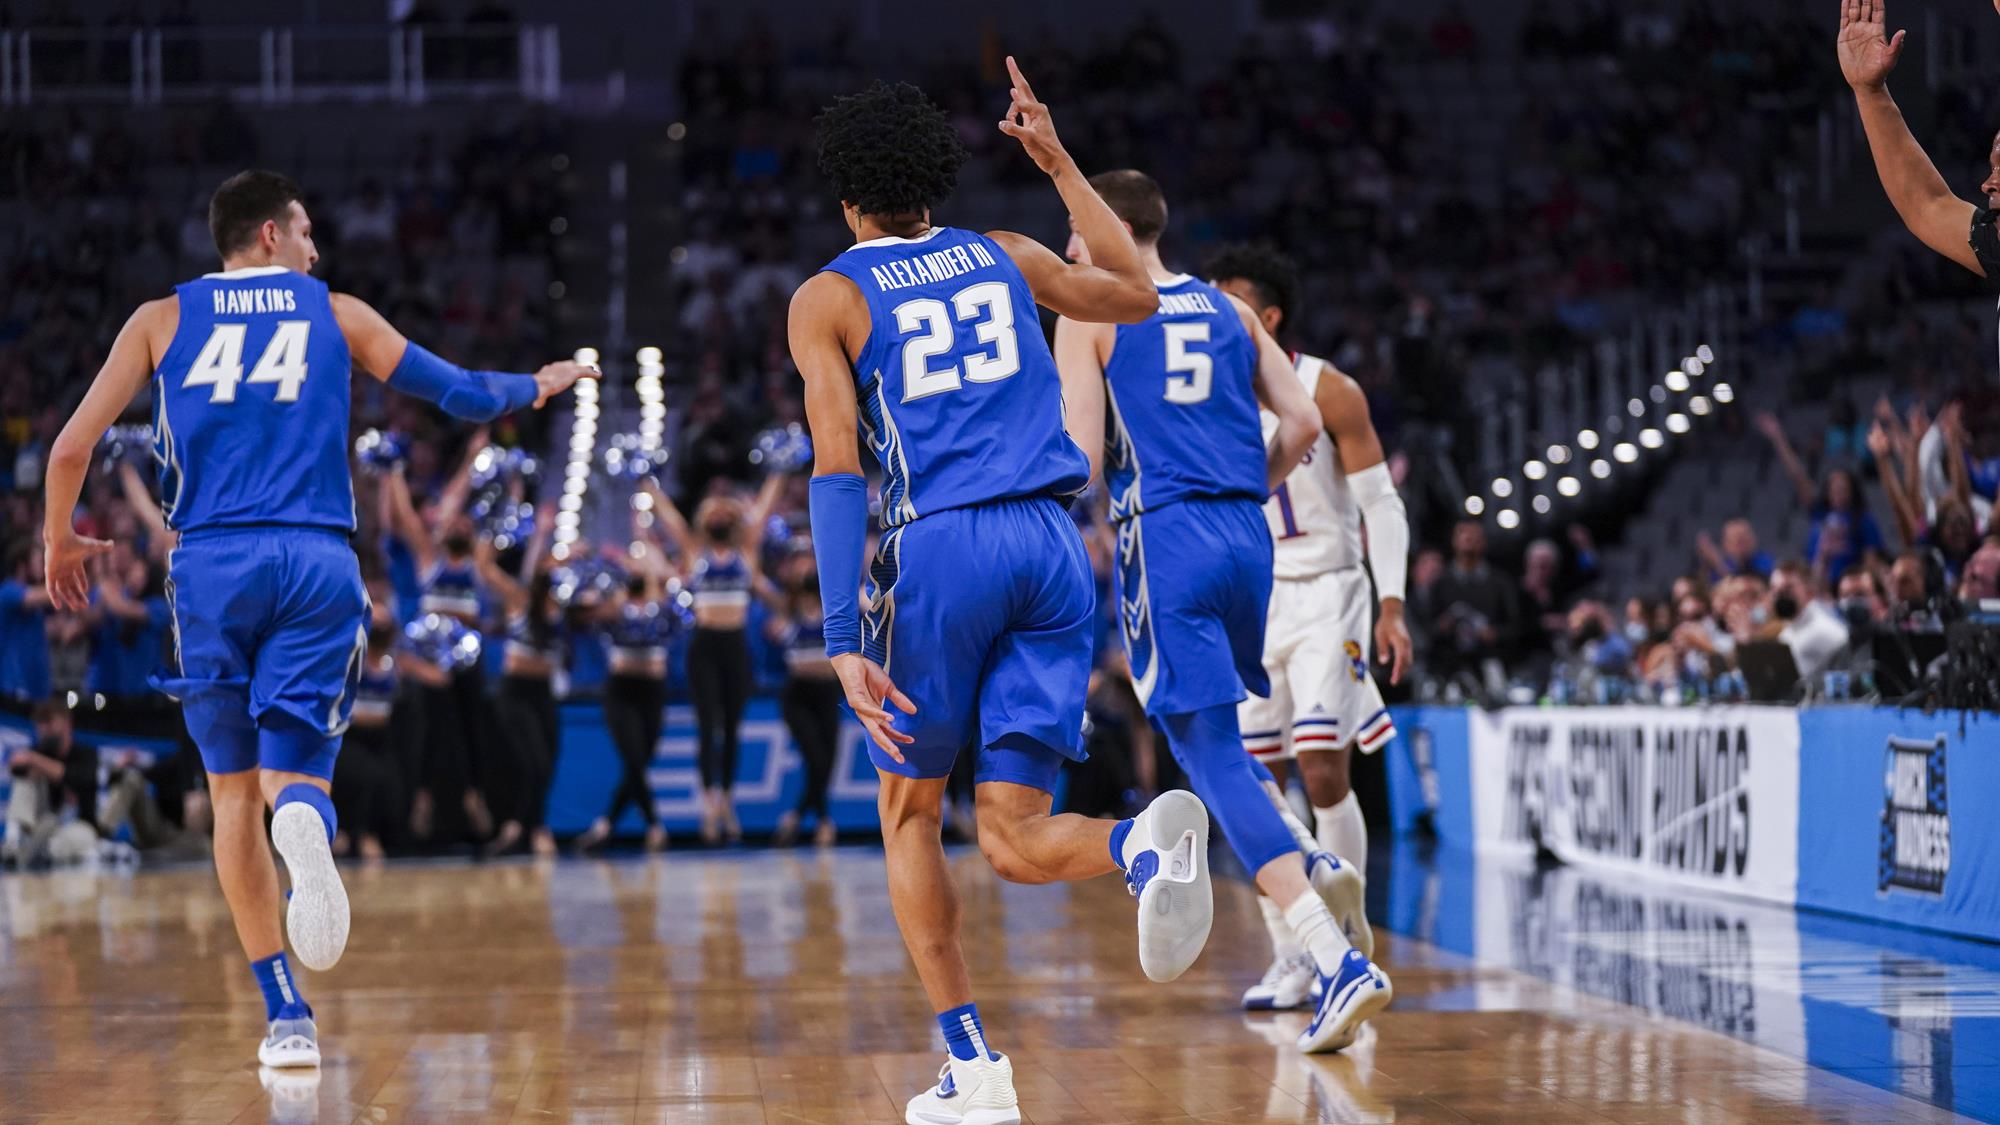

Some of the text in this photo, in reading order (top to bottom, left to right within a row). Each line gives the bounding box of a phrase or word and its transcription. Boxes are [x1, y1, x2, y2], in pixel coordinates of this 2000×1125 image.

[870, 242, 997, 292] ALEXANDER III
[213, 288, 297, 315] HAWKINS
[1157, 292, 1219, 316] ONNELL
[182, 319, 311, 404] 44
[891, 281, 1021, 404] 23
[1161, 322, 1214, 404] 5
